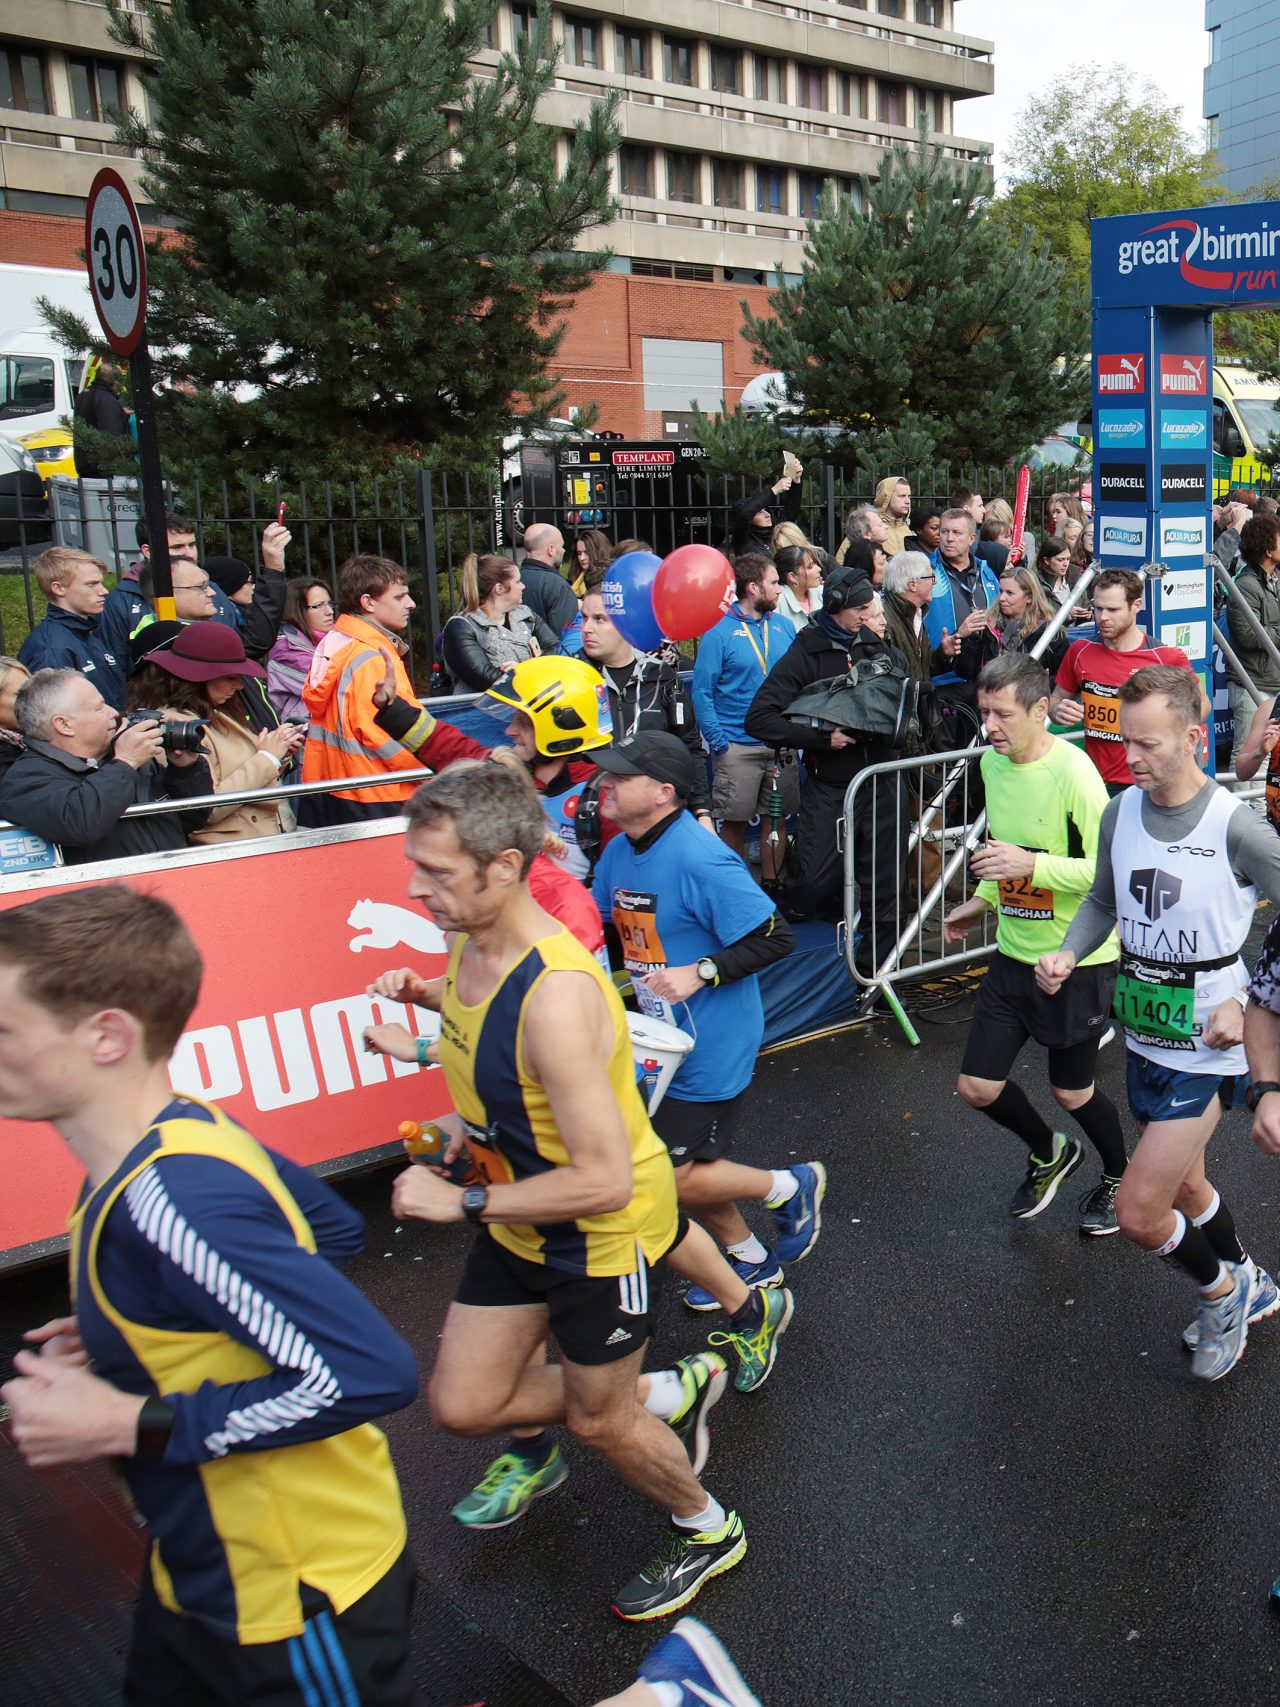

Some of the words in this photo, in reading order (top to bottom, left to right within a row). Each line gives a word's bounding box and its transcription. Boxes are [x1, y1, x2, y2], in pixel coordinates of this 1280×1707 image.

[1118, 231, 1179, 275] great
[93, 223, 137, 301] 30
[1234, 269, 1278, 290] run
[1100, 374, 1133, 391] PUMA
[1162, 374, 1196, 391] PUMA
[1100, 422, 1137, 433] Lucozade
[1162, 421, 1199, 434] Lucozade
[617, 453, 671, 463] TEMPLANT
[681, 448, 693, 457] GEN
[1101, 477, 1144, 488] DURACELL
[1162, 477, 1205, 489] DURACELL
[1177, 582, 1204, 590] Birmingham
[1086, 729, 1123, 741] MINGHA
[1167, 845, 1216, 858] orca
[1000, 905, 1052, 919] MINGHAM
[1122, 917, 1199, 954] TITAN
[1119, 992, 1188, 1029] 11404
[1128, 1028, 1194, 1050] MINGHAM
